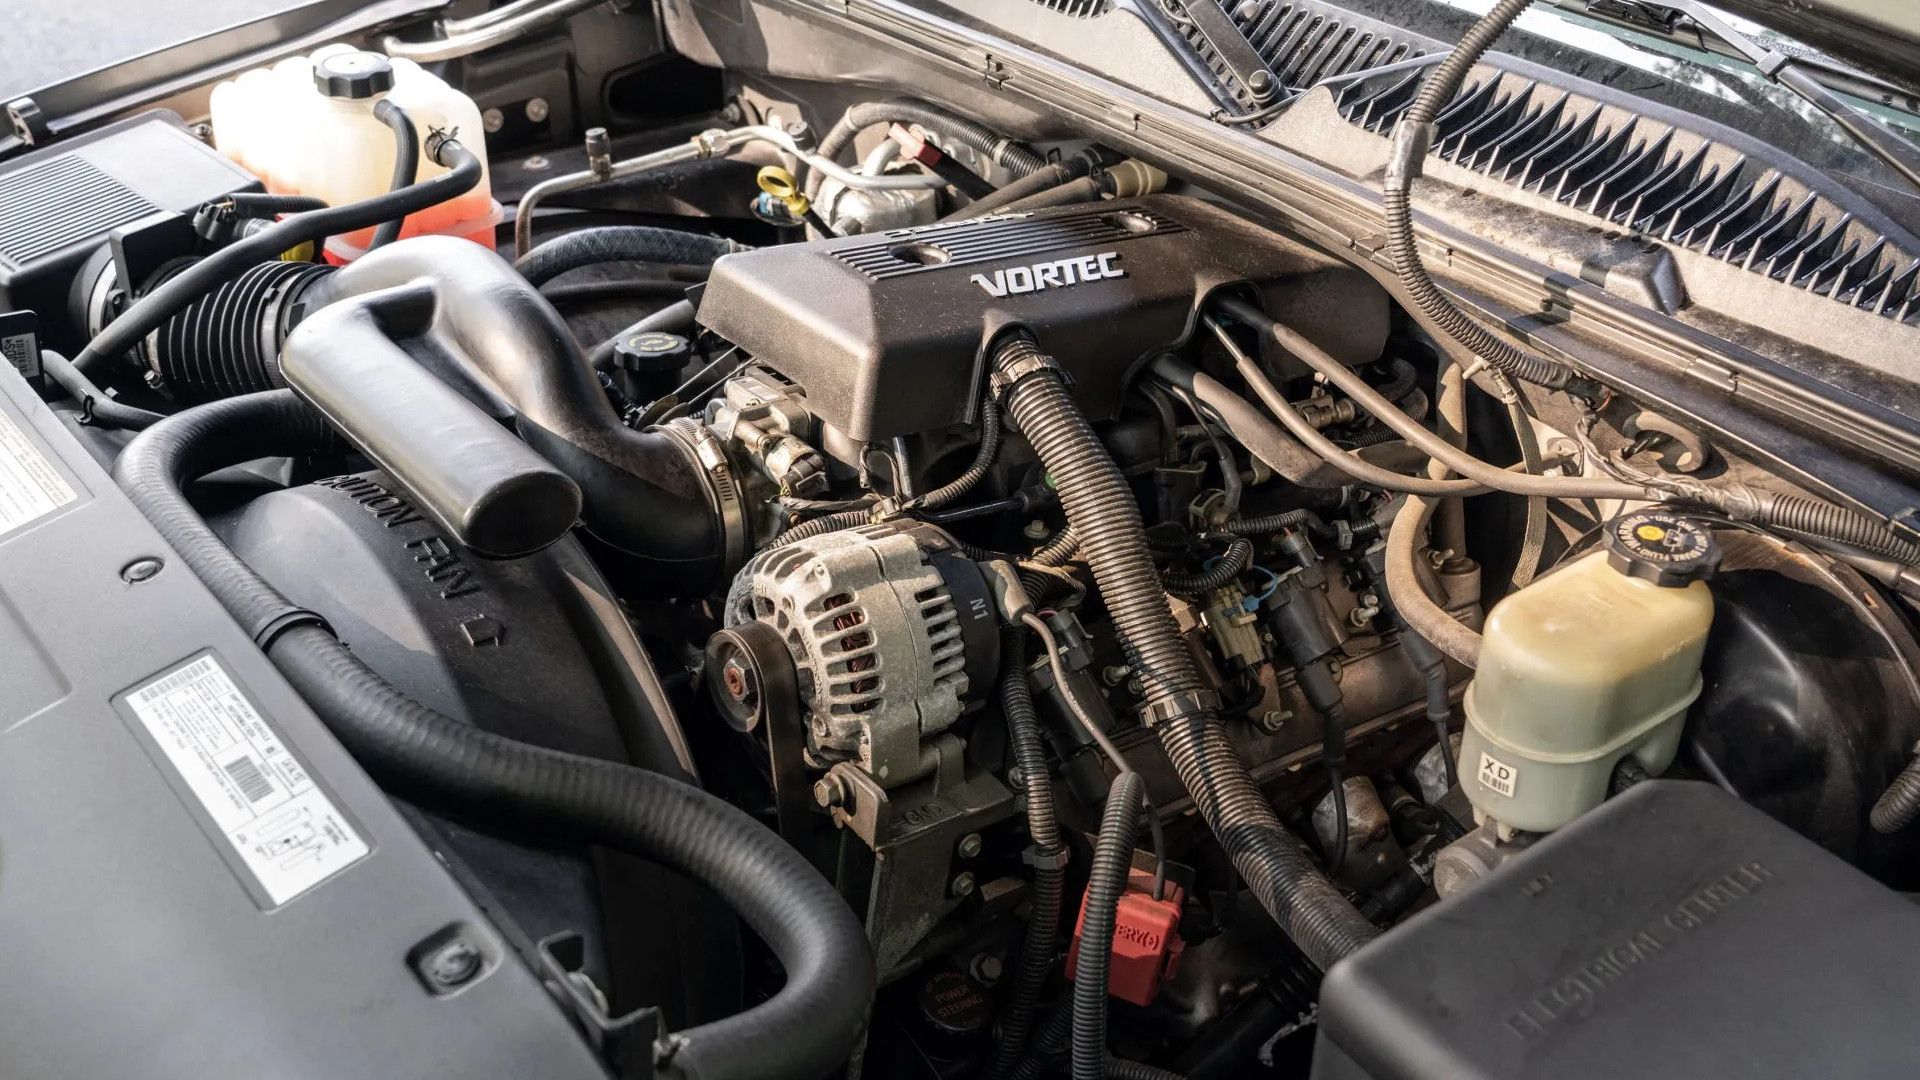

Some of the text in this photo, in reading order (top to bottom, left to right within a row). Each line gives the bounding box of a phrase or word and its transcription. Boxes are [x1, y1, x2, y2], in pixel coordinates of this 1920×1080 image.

[971, 251, 1125, 299] VORTEC
[1655, 515, 1676, 524] USE
[1639, 548, 1670, 561] FLUID
[404, 536, 482, 599] FAN
[970, 598, 989, 620] N1
[1117, 924, 1160, 951] ERY(+)
